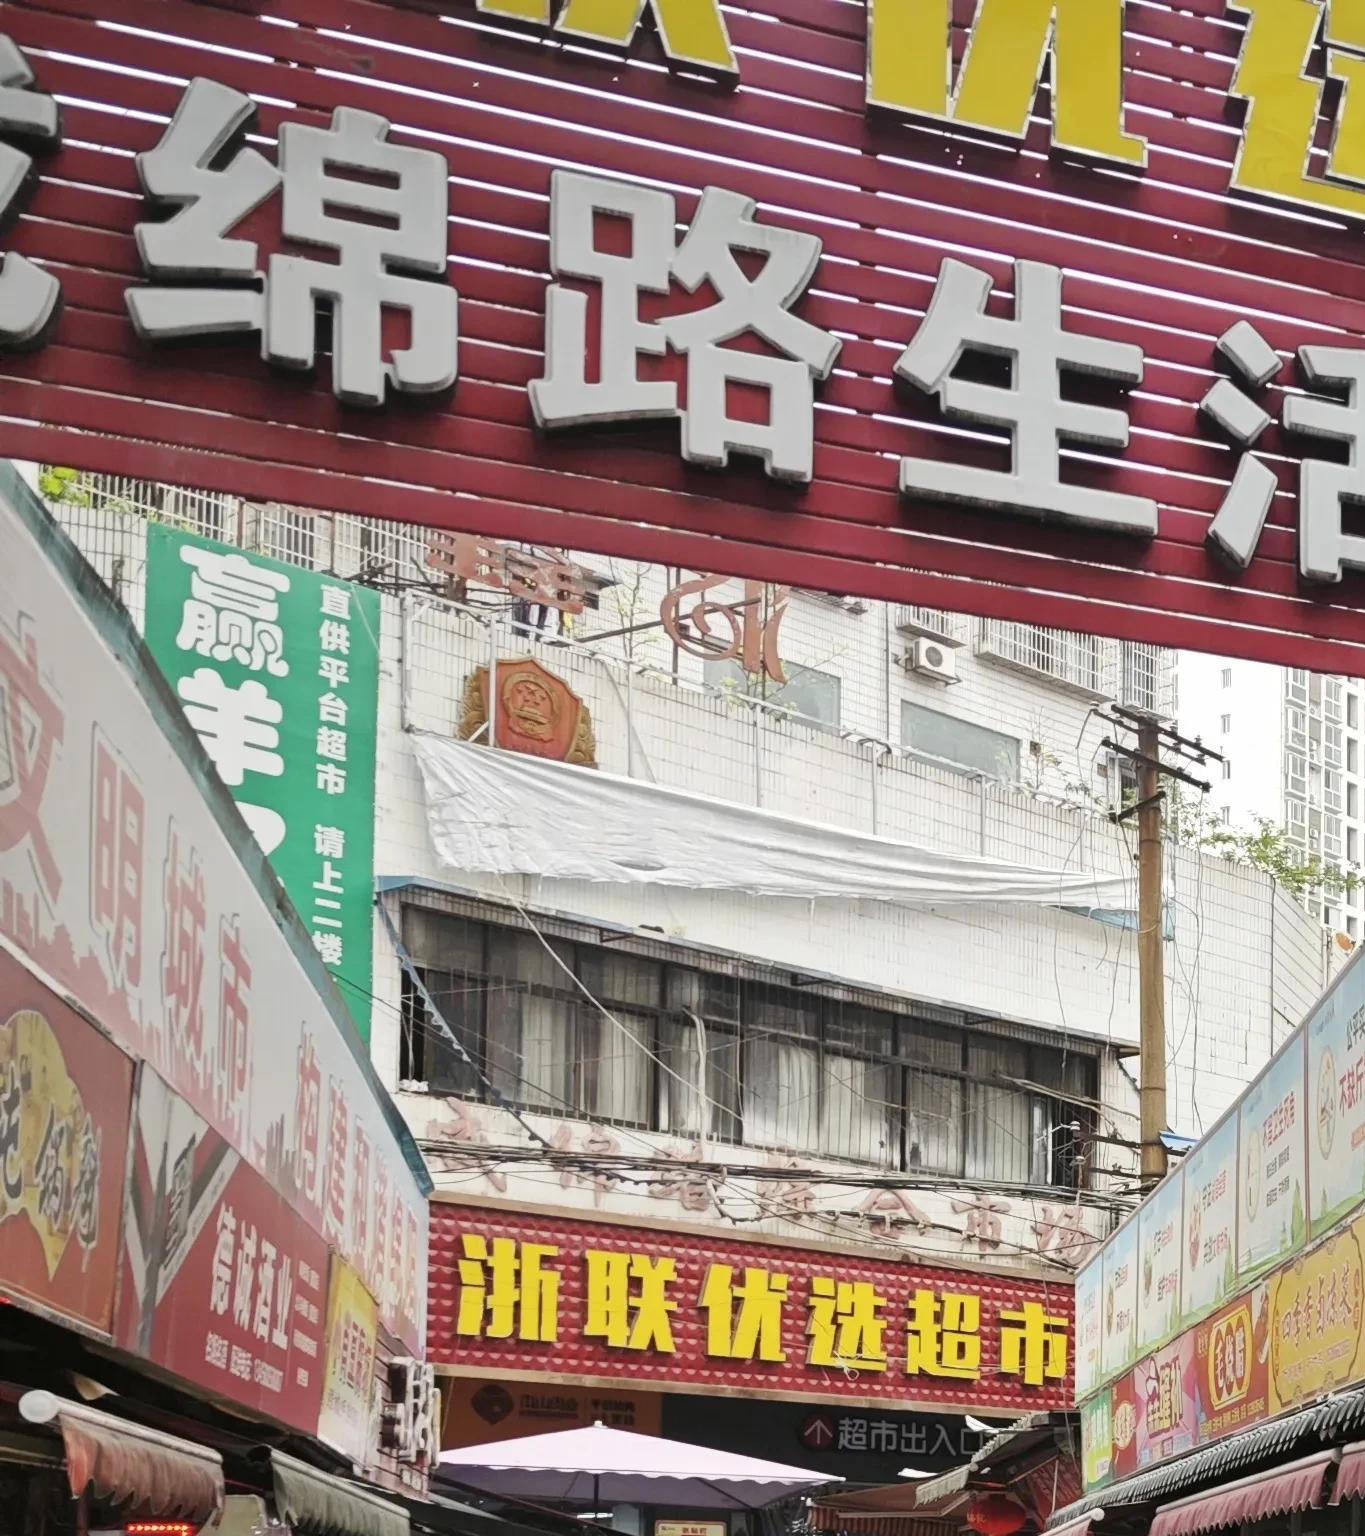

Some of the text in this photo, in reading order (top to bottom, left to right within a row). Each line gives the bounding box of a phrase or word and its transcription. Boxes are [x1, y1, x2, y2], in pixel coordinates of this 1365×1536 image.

[311, 583, 352, 967] 直供平台超市 请上二楼
[456, 1233, 1069, 1388] 浙联优选超市
[838, 1416, 986, 1458] 超市出入口
